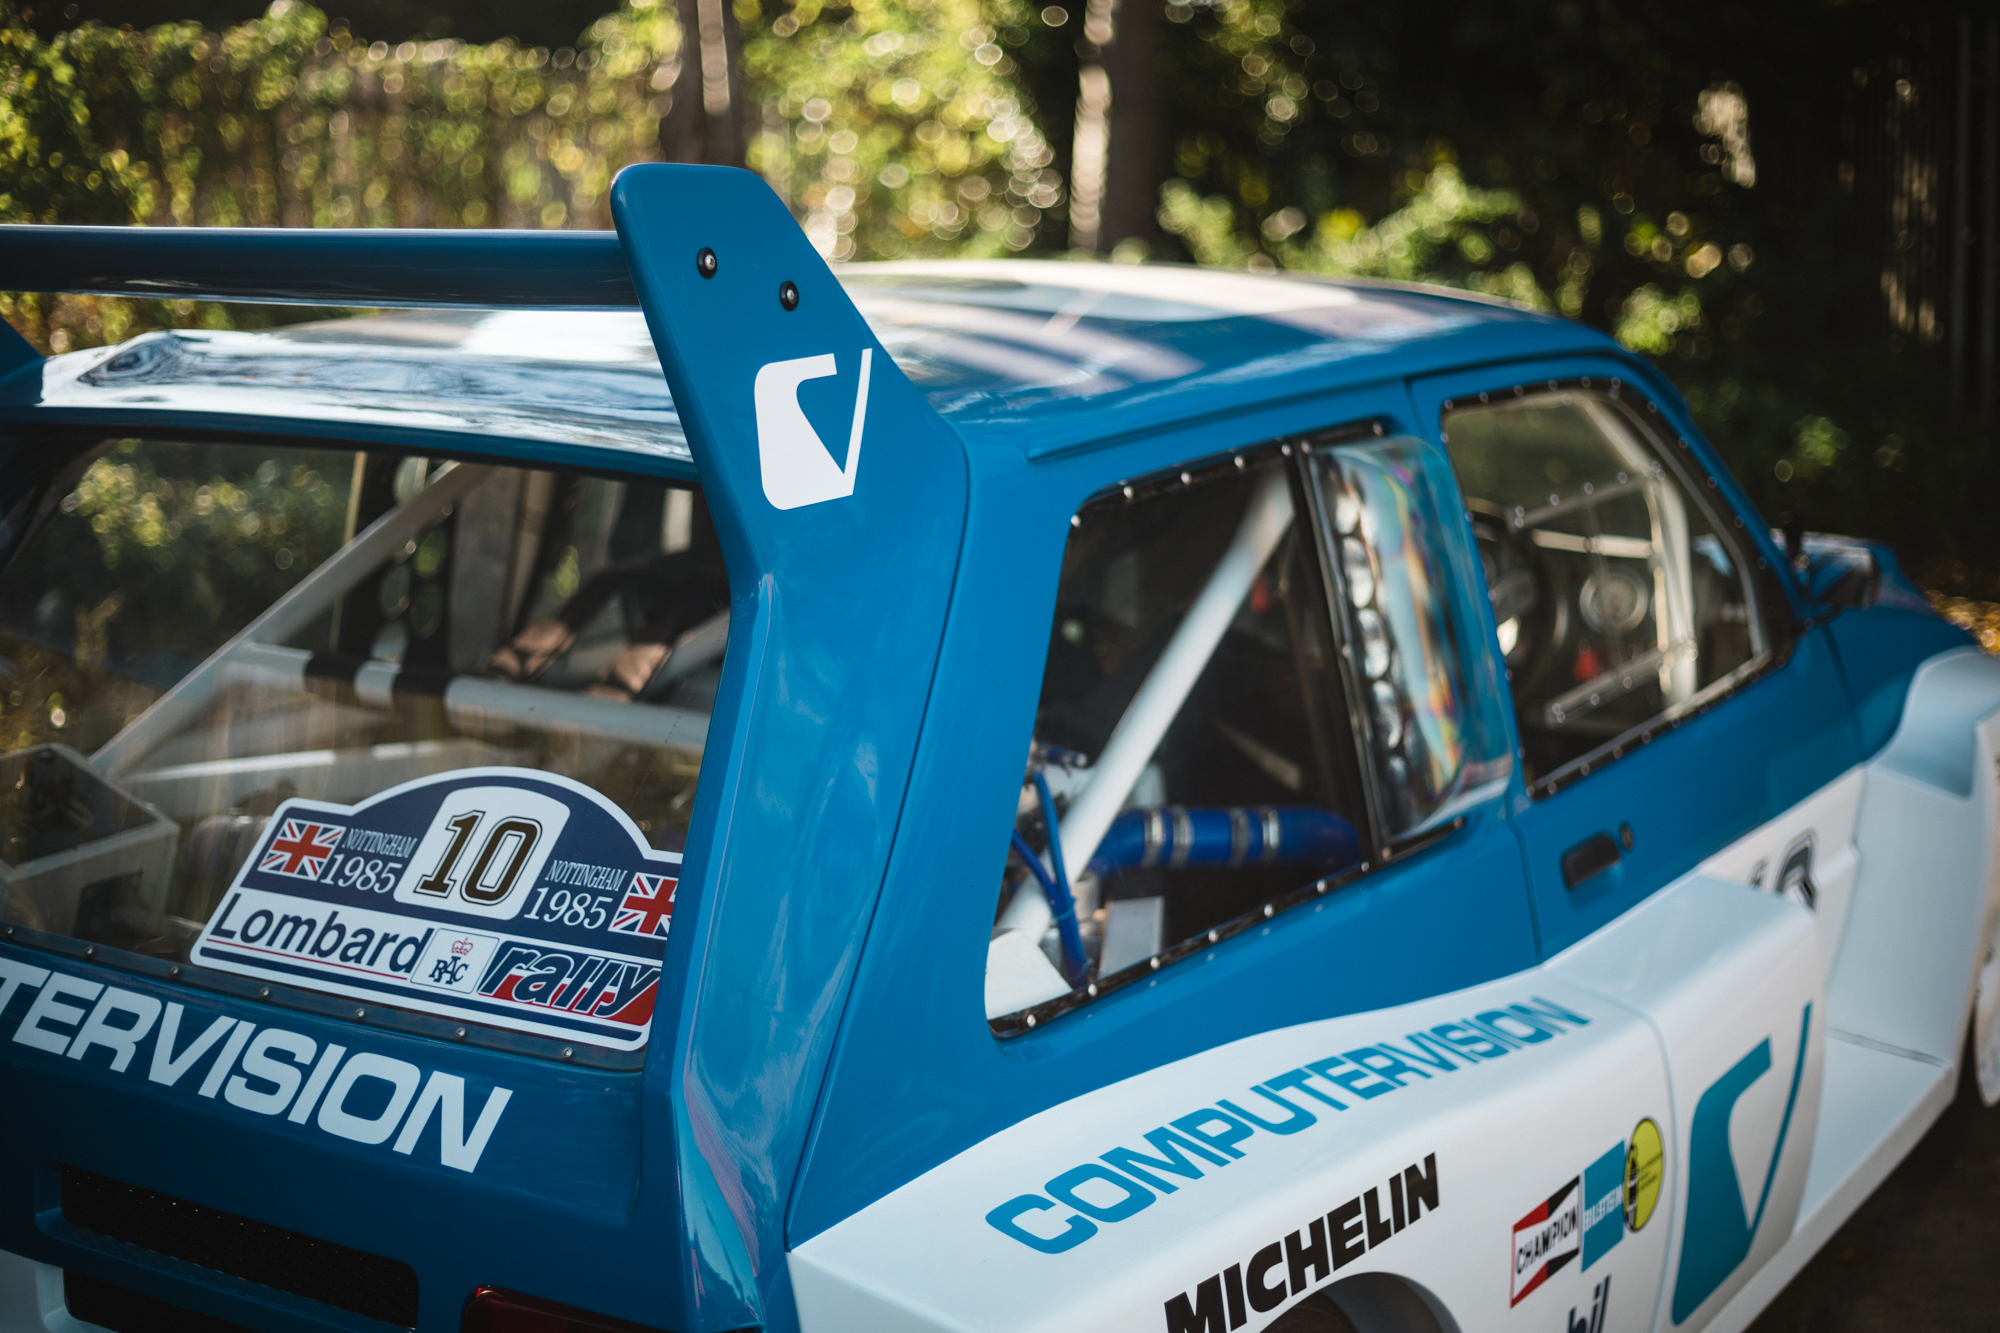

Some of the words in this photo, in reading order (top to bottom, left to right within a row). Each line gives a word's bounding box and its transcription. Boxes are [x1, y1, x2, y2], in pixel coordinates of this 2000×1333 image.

[320, 854, 403, 894] 1985
[341, 828, 418, 858] NOTTINGHAM
[413, 810, 543, 906] 10
[545, 860, 628, 892] NOTTINGHAM
[524, 887, 613, 929] 1985
[210, 893, 434, 974] Lombard
[429, 956, 469, 985] RAC
[478, 947, 661, 1018] rally
[0, 957, 513, 1173] TERVISION
[985, 996, 1591, 1254] COMPUTERVISION
[1164, 1152, 1439, 1333] MICHELIN
[1515, 1204, 1579, 1275] CHAMPION
